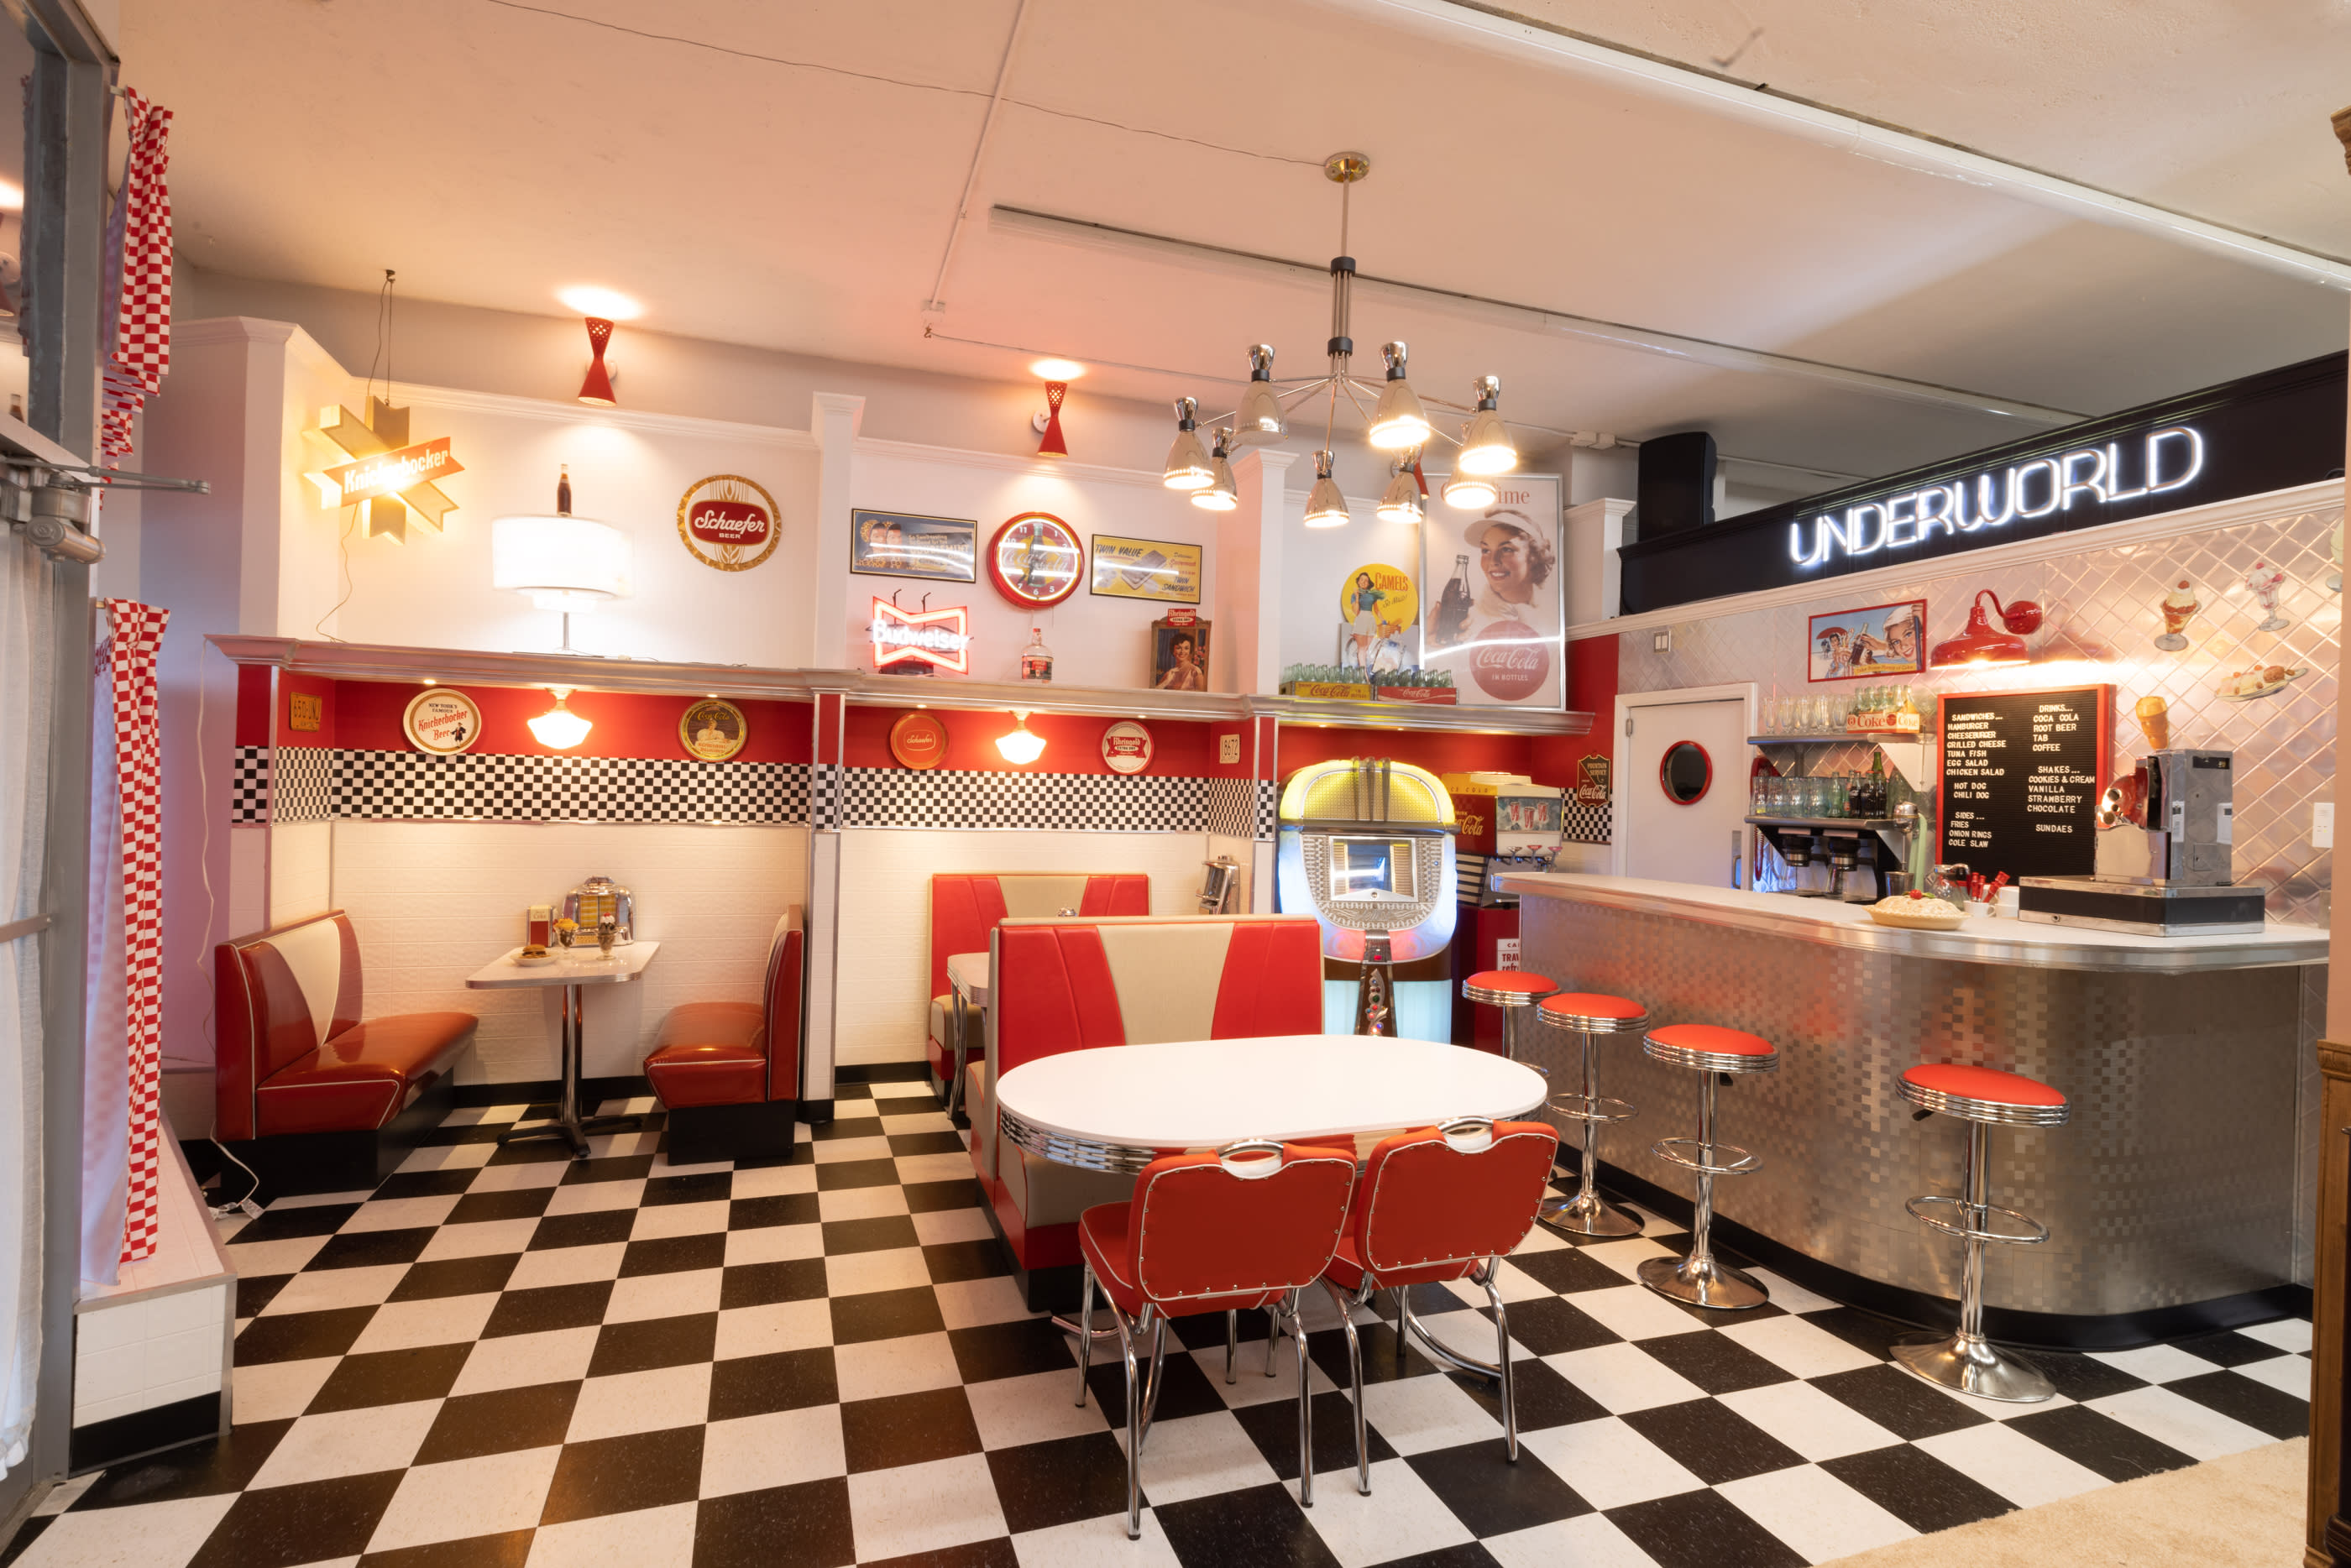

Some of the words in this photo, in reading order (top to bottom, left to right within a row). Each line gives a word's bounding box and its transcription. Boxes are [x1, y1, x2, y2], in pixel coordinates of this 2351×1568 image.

[343, 449, 448, 494] Knickbocker
[1495, 484, 1530, 504] ime
[1789, 426, 2204, 566] UNDERWORLD
[694, 510, 765, 535] Schaefer
[1095, 543, 1116, 554] TWIN
[1118, 546, 1144, 558] VALUE
[1173, 576, 1190, 584] TWIN
[1374, 572, 1408, 592] CAMELS
[1161, 583, 1196, 593] SANDWICH
[873, 619, 970, 651] Budweiser
[1476, 646, 1538, 670] Coca-Cola
[1310, 684, 1351, 698] Coca-Cola
[418, 710, 468, 732] Knickerbocker
[1857, 715, 1885, 728] Coke
[2033, 714, 2054, 723] COCA
[2059, 713, 2079, 722] COLA
[1947, 722, 1989, 730] HAMBURGER
[2033, 724, 2053, 733] ROOT
[2055, 723, 2077, 732] BEER
[432, 729, 450, 740] Beer
[1947, 731, 1997, 740] CHEESEBURGER
[2033, 734, 2049, 742] TAB
[1946, 740, 1976, 749] GRILLED
[1978, 740, 2007, 748] CHEESE
[2032, 743, 2061, 752] COFFEE
[2069, 776, 2096, 784] CREAM
[1579, 784, 1607, 799] Coca-Cola
[2028, 785, 2065, 793] VANILLA
[2027, 804, 2076, 813] CHOCOLATE
[1950, 820, 1969, 828] FRIES
[2035, 823, 2073, 834] SUNDAES
[1949, 829, 1970, 838] ONION
[1971, 830, 1992, 839] RINGS
[1948, 839, 1966, 847] COLE
[1970, 839, 1989, 848] SLAW
